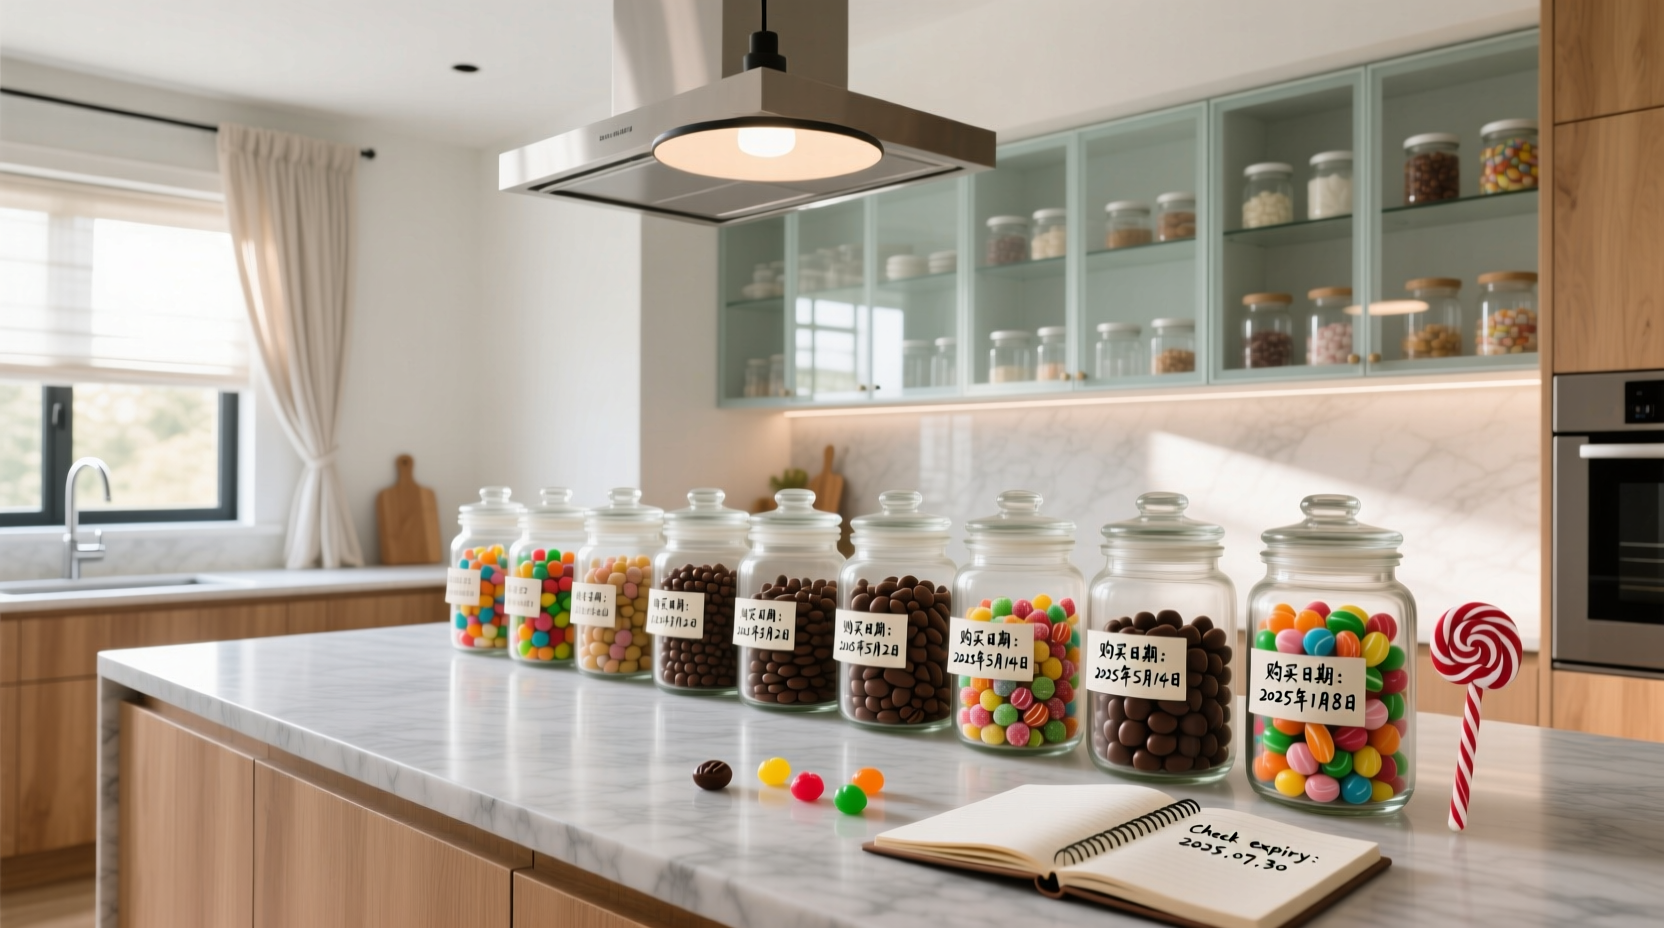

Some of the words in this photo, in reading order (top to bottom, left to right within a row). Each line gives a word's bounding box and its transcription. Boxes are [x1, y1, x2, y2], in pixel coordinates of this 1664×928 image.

[960, 628, 1018, 649] 购买日期：
[953, 650, 1028, 672] 2025年5月14日
[1099, 640, 1166, 663] 购买日期：
[1095, 665, 1180, 688] 2025年5月14日
[1265, 661, 1342, 686] 购买日期：
[1259, 688, 1356, 712] 2025年1月8日
[1178, 837, 1288, 871] 2025.07.30
[1189, 824, 1240, 844] Check
[1249, 840, 1319, 864] expiry:
